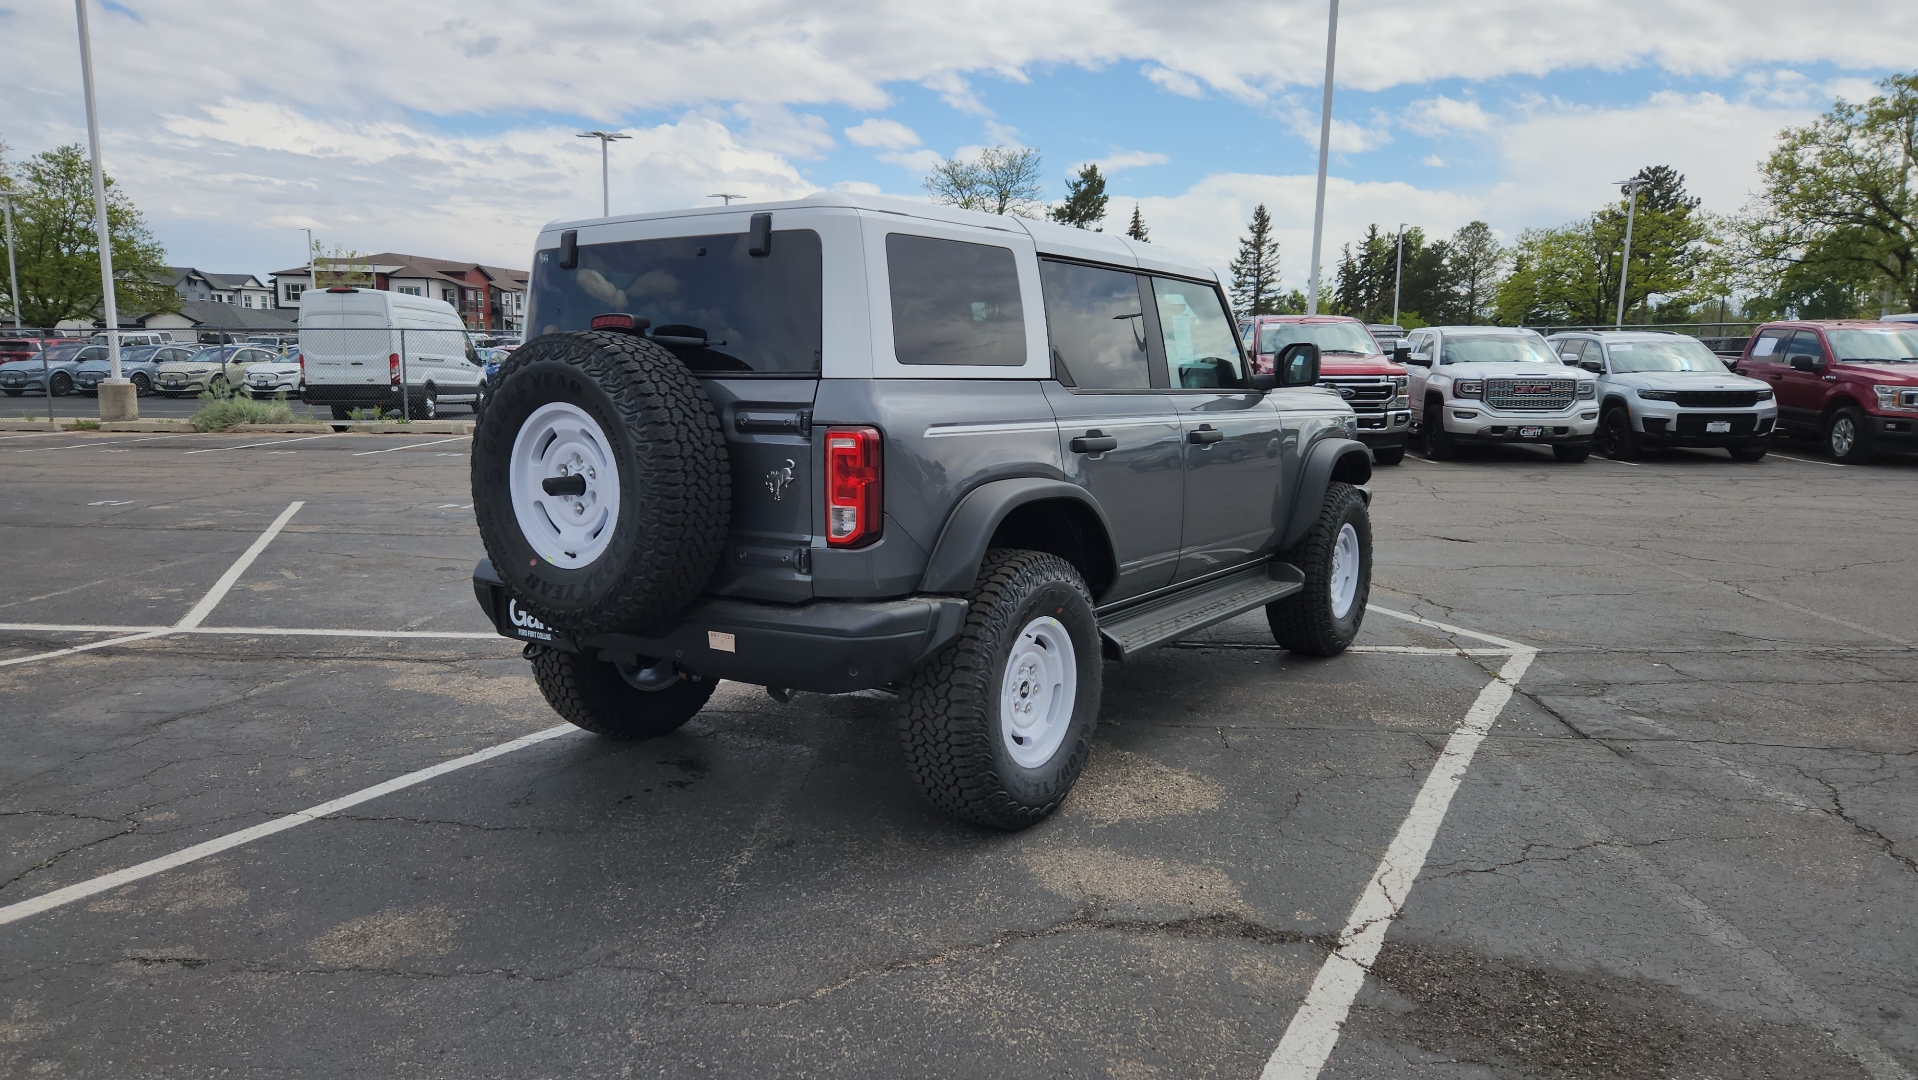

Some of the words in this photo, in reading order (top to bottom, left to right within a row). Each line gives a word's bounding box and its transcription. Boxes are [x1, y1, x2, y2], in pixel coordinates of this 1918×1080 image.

[482, 372, 583, 456] GOODYEAR
[1514, 385, 1551, 393] GMC
[526, 521, 629, 604] GOODYEAR
